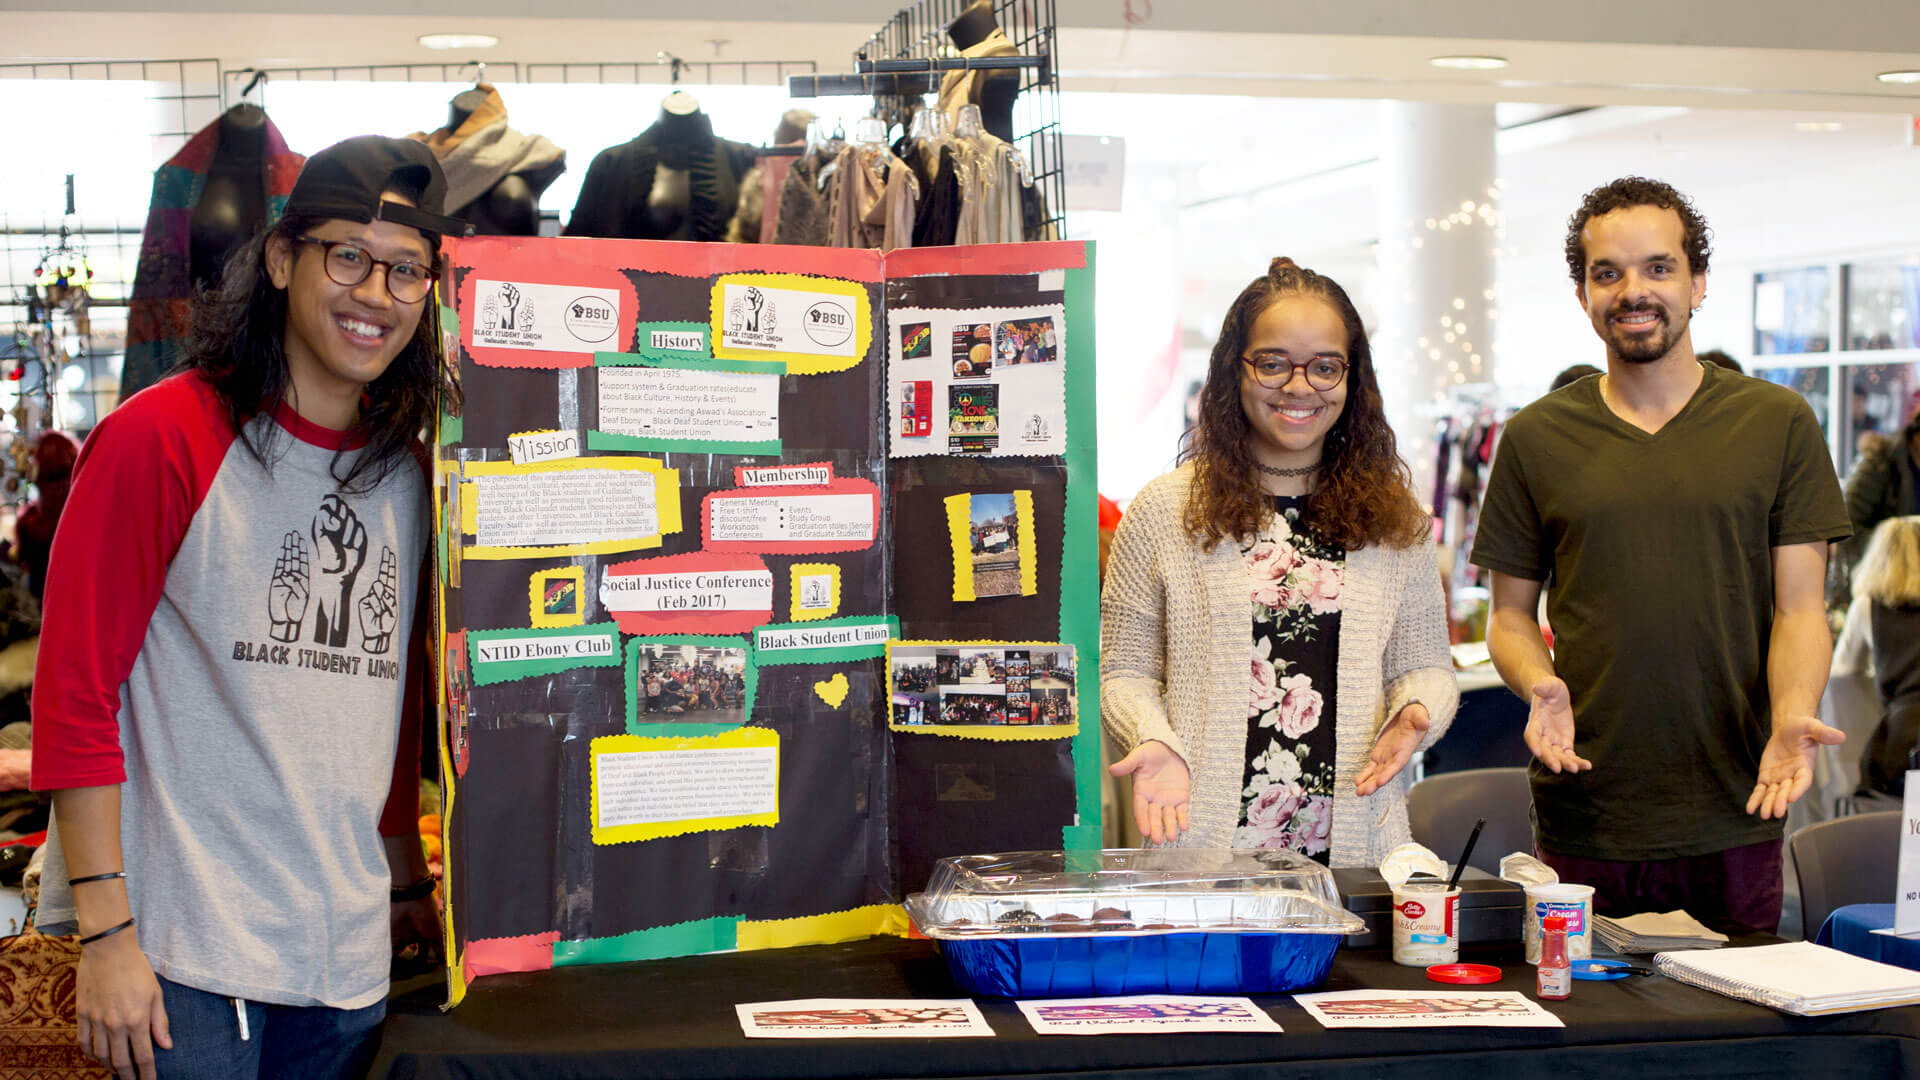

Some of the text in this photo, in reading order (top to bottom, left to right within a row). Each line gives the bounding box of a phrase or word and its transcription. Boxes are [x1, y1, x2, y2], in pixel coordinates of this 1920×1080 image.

[585, 308, 610, 320] BSU
[822, 312, 844, 325] BSU
[741, 332, 764, 340] STUDENT
[652, 334, 703, 351] History
[603, 368, 632, 376] Founded
[603, 382, 630, 391] Support
[675, 394, 700, 403] History
[657, 408, 694, 416] Ascending
[963, 406, 986, 416] LOVE
[621, 417, 641, 425] Ebony
[509, 436, 576, 462] Mission
[746, 468, 827, 484] Membership
[750, 500, 778, 508] Meeting
[601, 576, 771, 592] Social Justice Conference
[657, 595, 726, 610] (Feb 2017)
[760, 627, 887, 649] Black Student Union
[480, 639, 611, 660] NTID Ebony Club
[232, 641, 399, 680] BLACK STUDENT UNIO
[1906, 892, 1917, 901] NO
